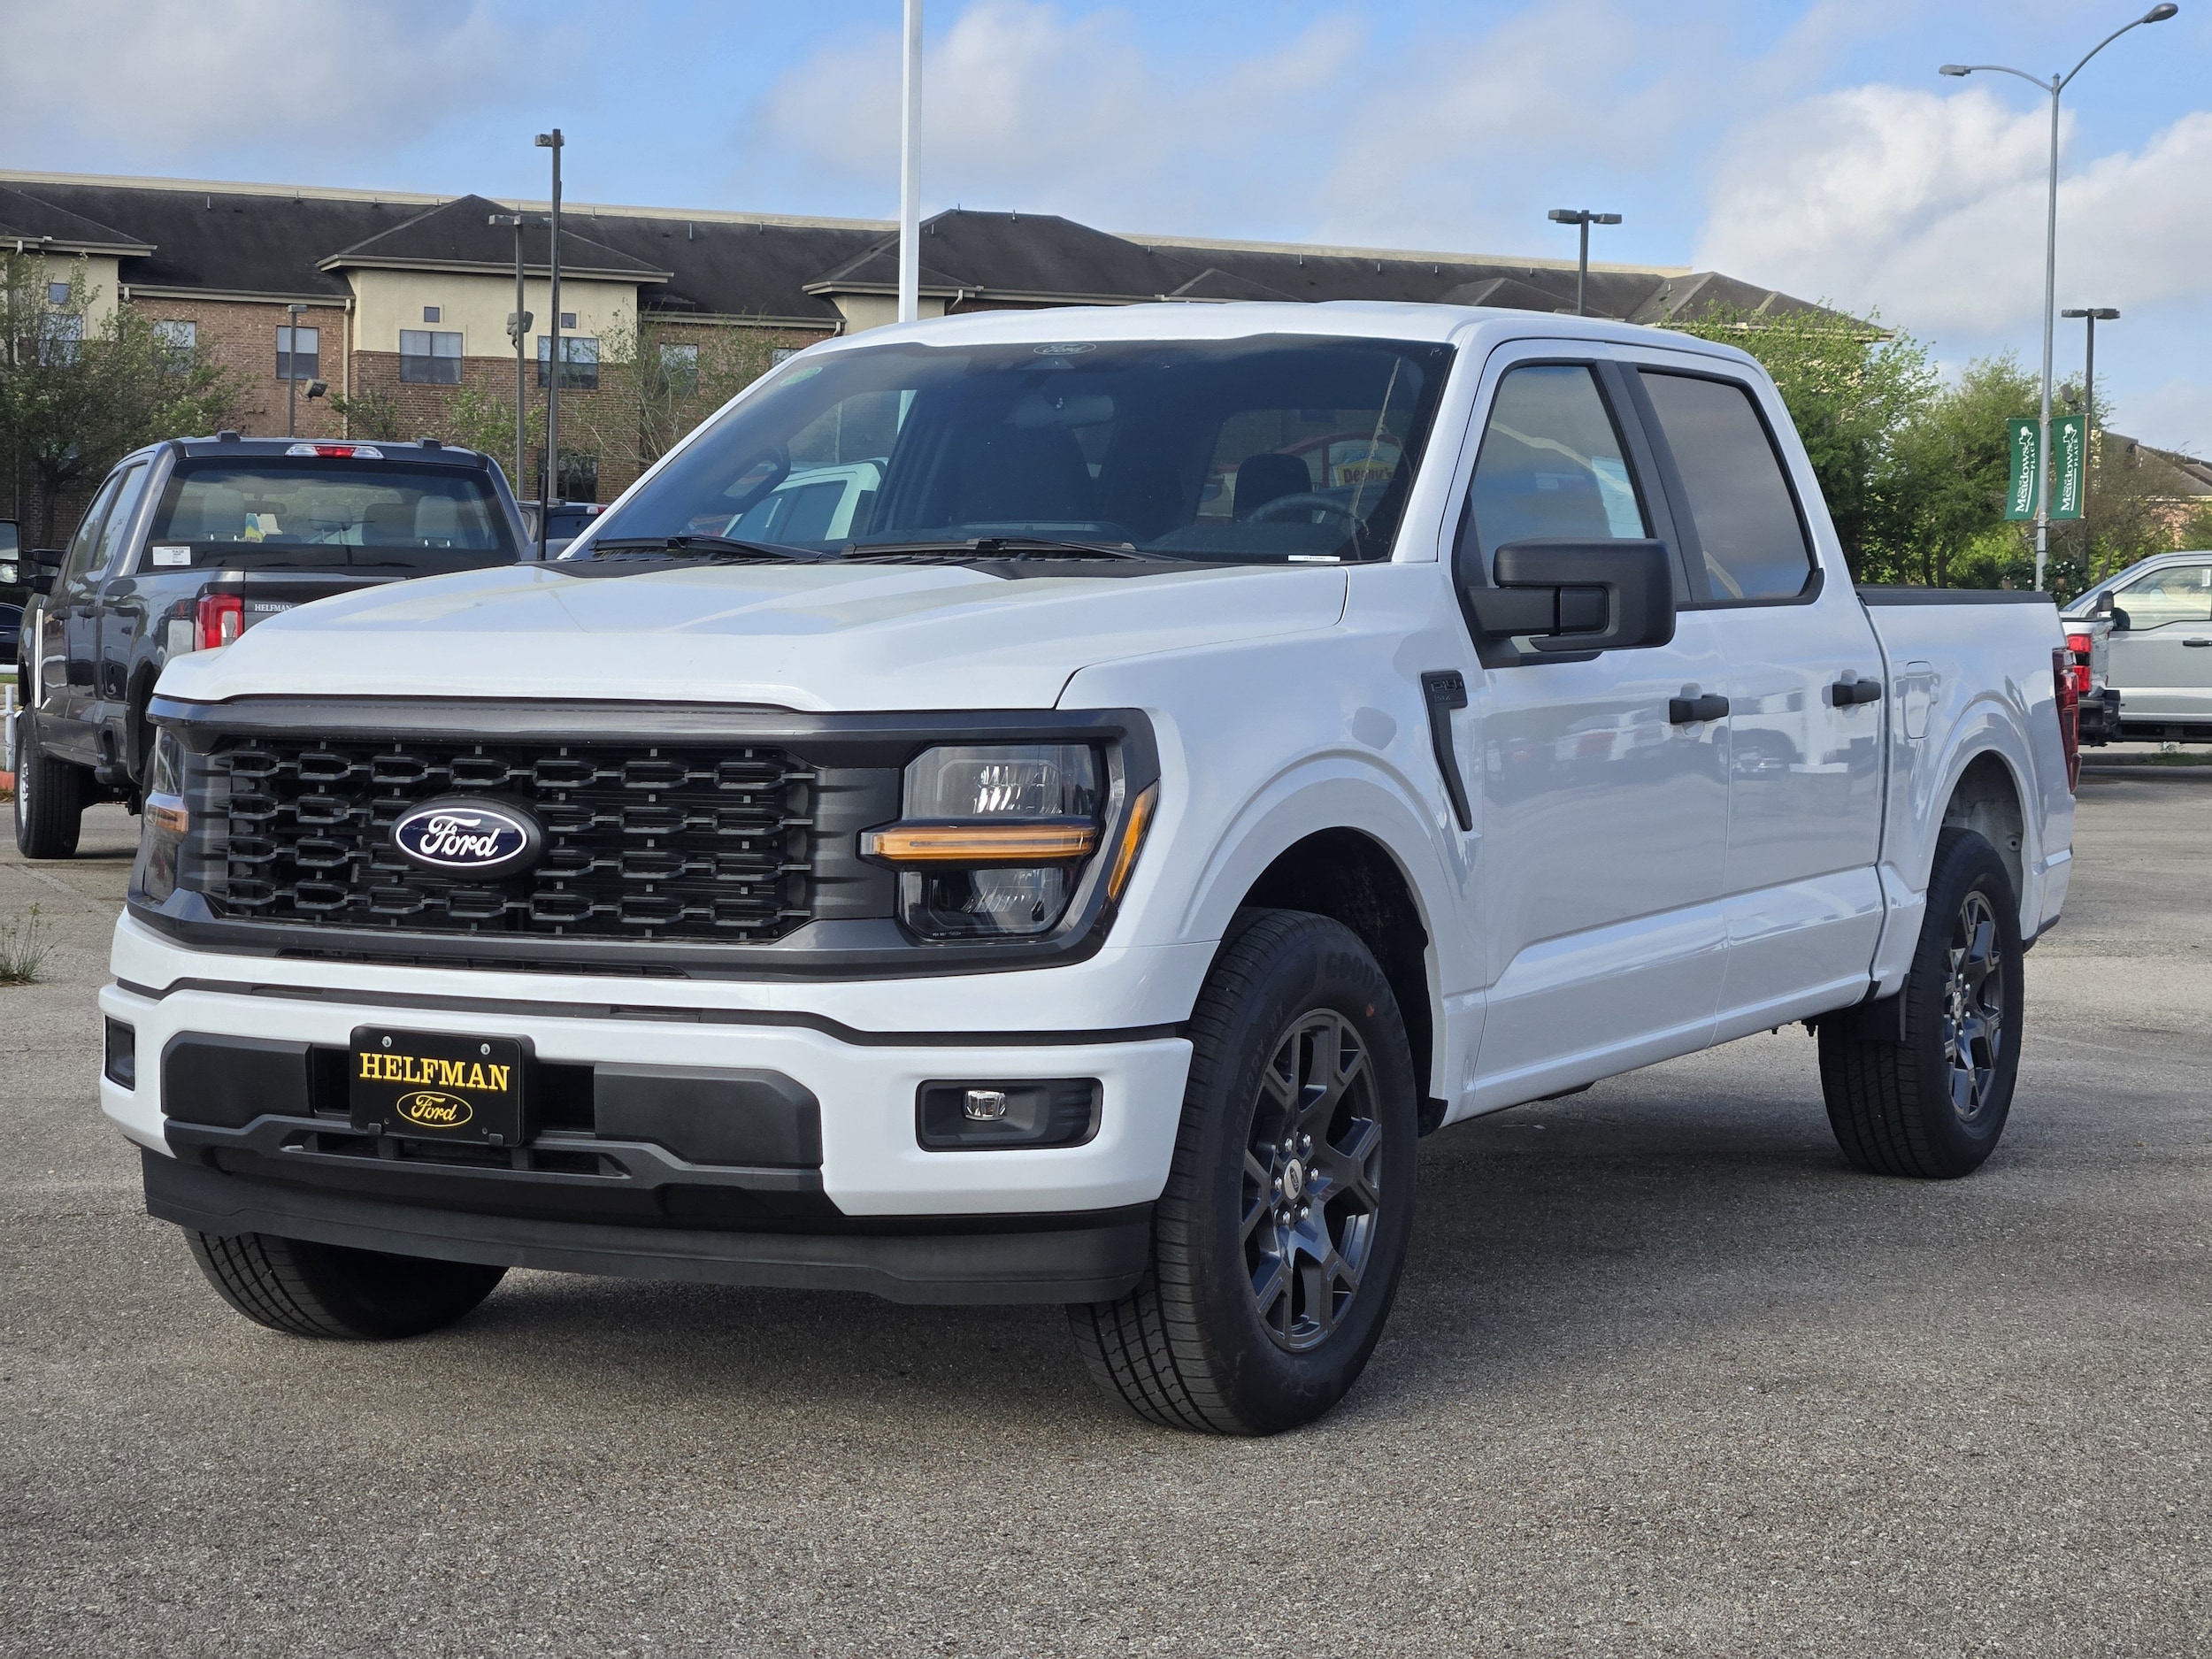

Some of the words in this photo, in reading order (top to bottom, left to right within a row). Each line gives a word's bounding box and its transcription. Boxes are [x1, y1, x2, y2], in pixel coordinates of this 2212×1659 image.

[1041, 342, 1087, 353] Ford
[2015, 447, 2030, 512] Meadows
[2061, 446, 2073, 511] Meadows
[419, 815, 502, 857] Ford
[359, 1051, 511, 1091] HELFMAN
[411, 1094, 457, 1122] Ford
